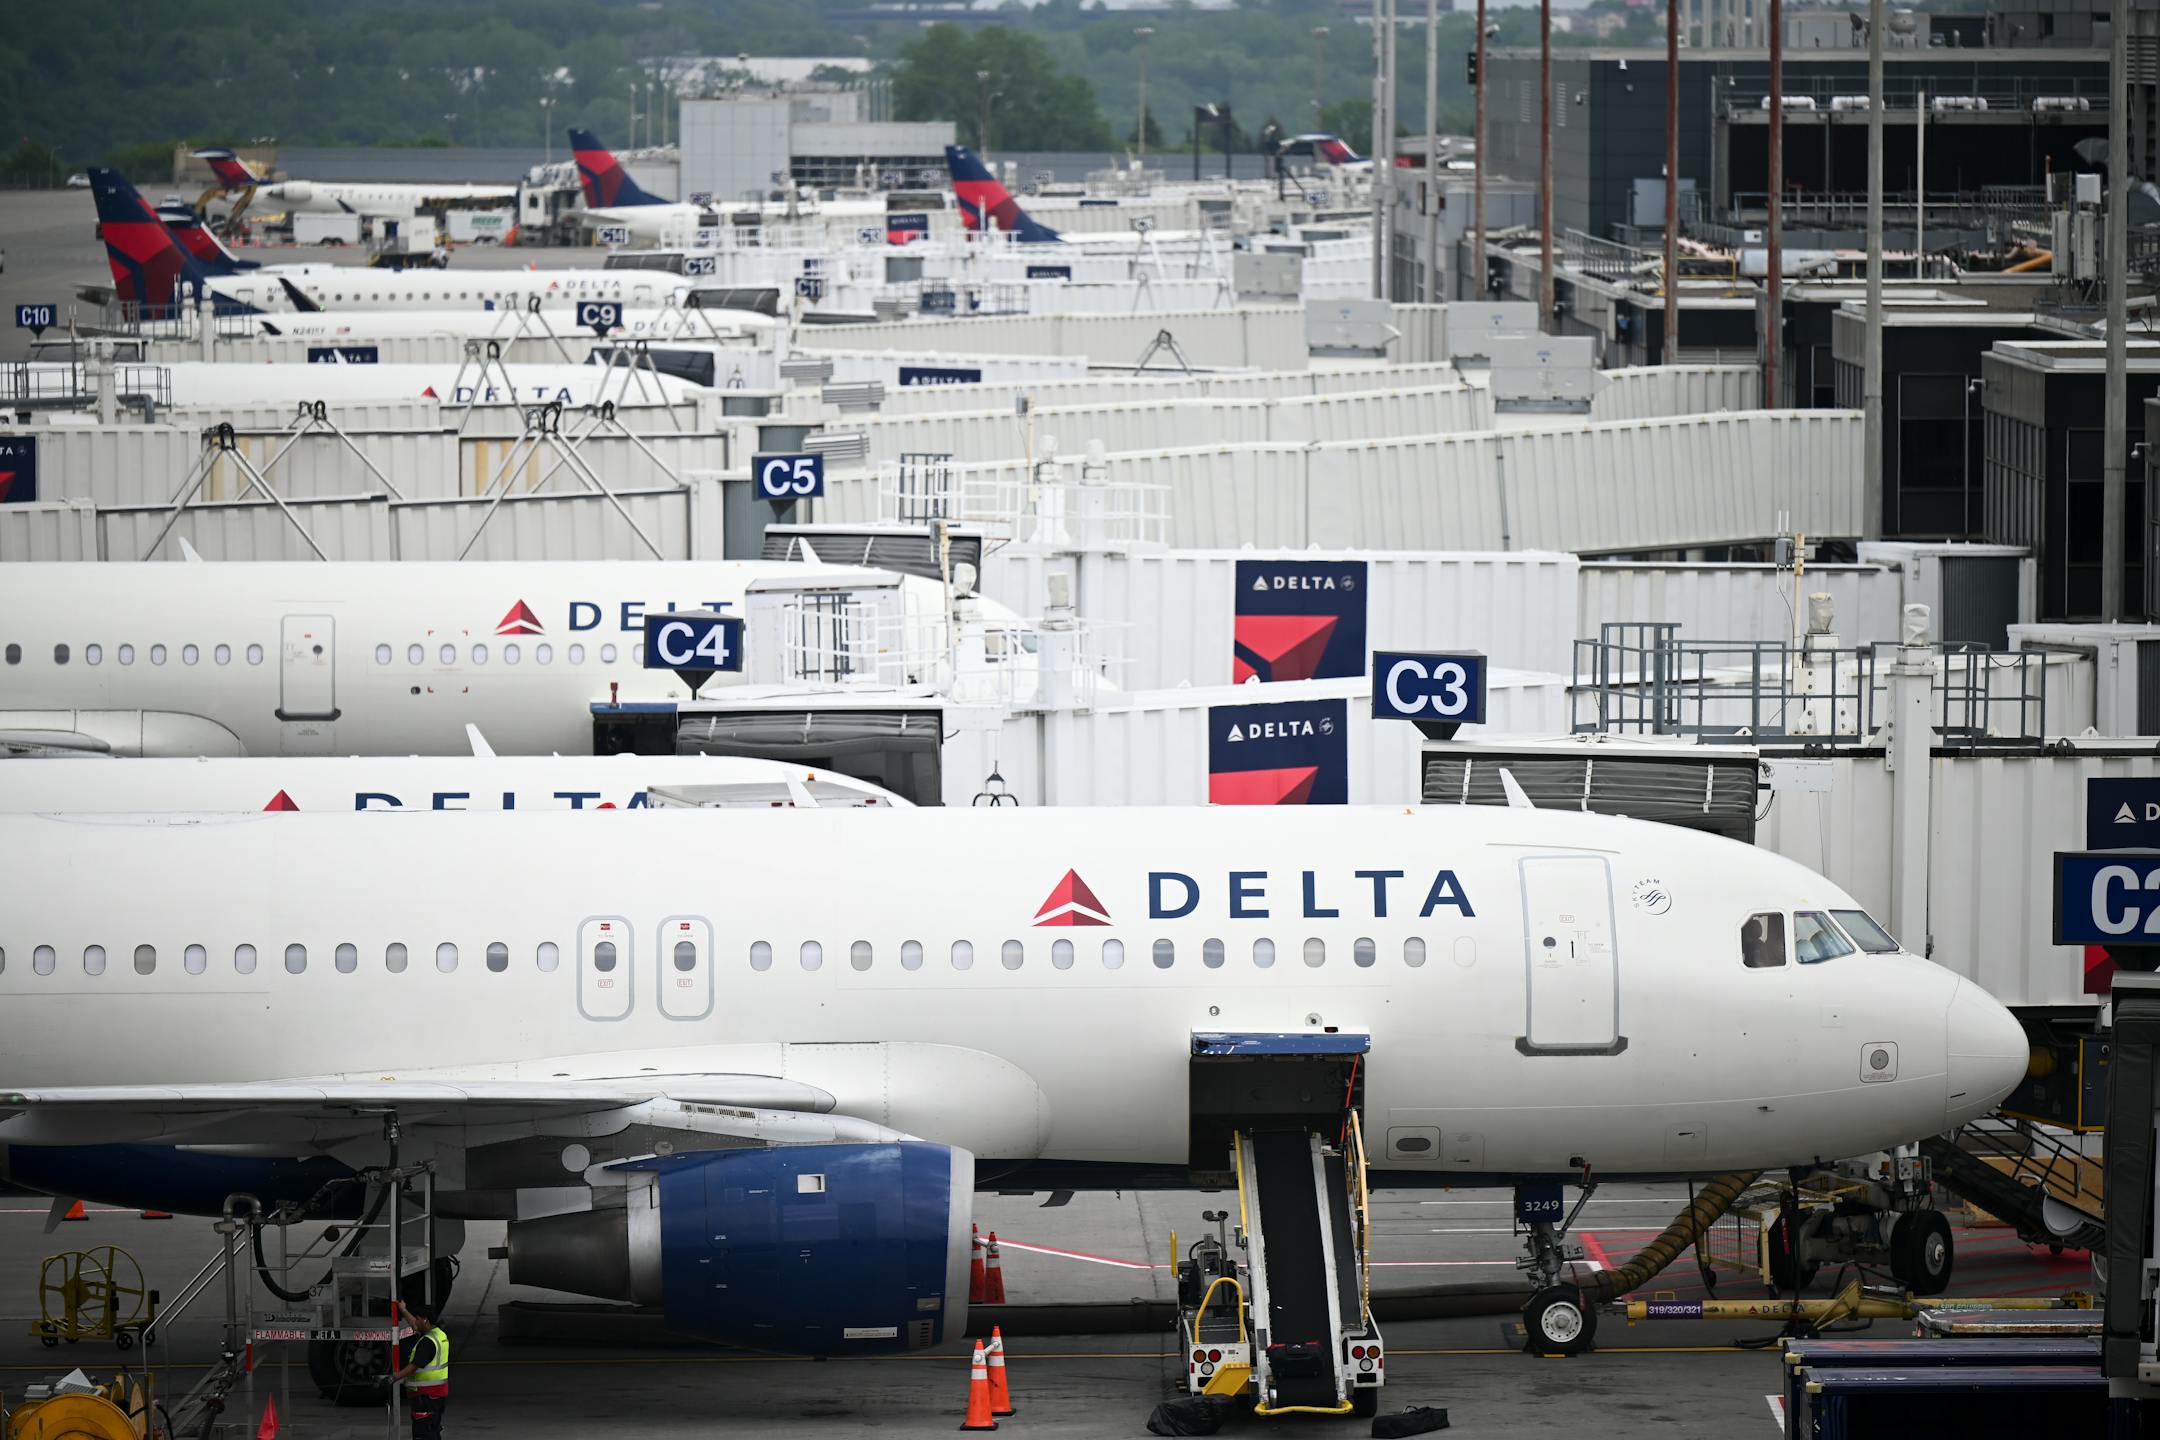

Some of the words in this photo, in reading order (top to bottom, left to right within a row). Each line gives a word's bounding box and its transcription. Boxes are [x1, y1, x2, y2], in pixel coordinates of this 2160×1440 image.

[686, 258, 715, 274] C12
[566, 280, 621, 289] DELTA
[796, 279, 821, 297] C11
[22, 307, 50, 325] C10
[583, 304, 616, 325] C9
[763, 459, 816, 496] C5
[1273, 576, 1336, 590] DELTA
[657, 621, 730, 666] C4
[1386, 659, 1468, 716] C3
[1249, 720, 1315, 739] DELTA
[1148, 869, 1476, 919] DELTA
[1632, 878, 1661, 909] SKYTEAM
[1525, 1200, 1560, 1211] 3249
[1648, 1306, 1701, 1314] 319/320/321
[256, 1330, 305, 1339] FLAMMABLE
[315, 1331, 328, 1339] JET
[330, 1331, 336, 1339] A
